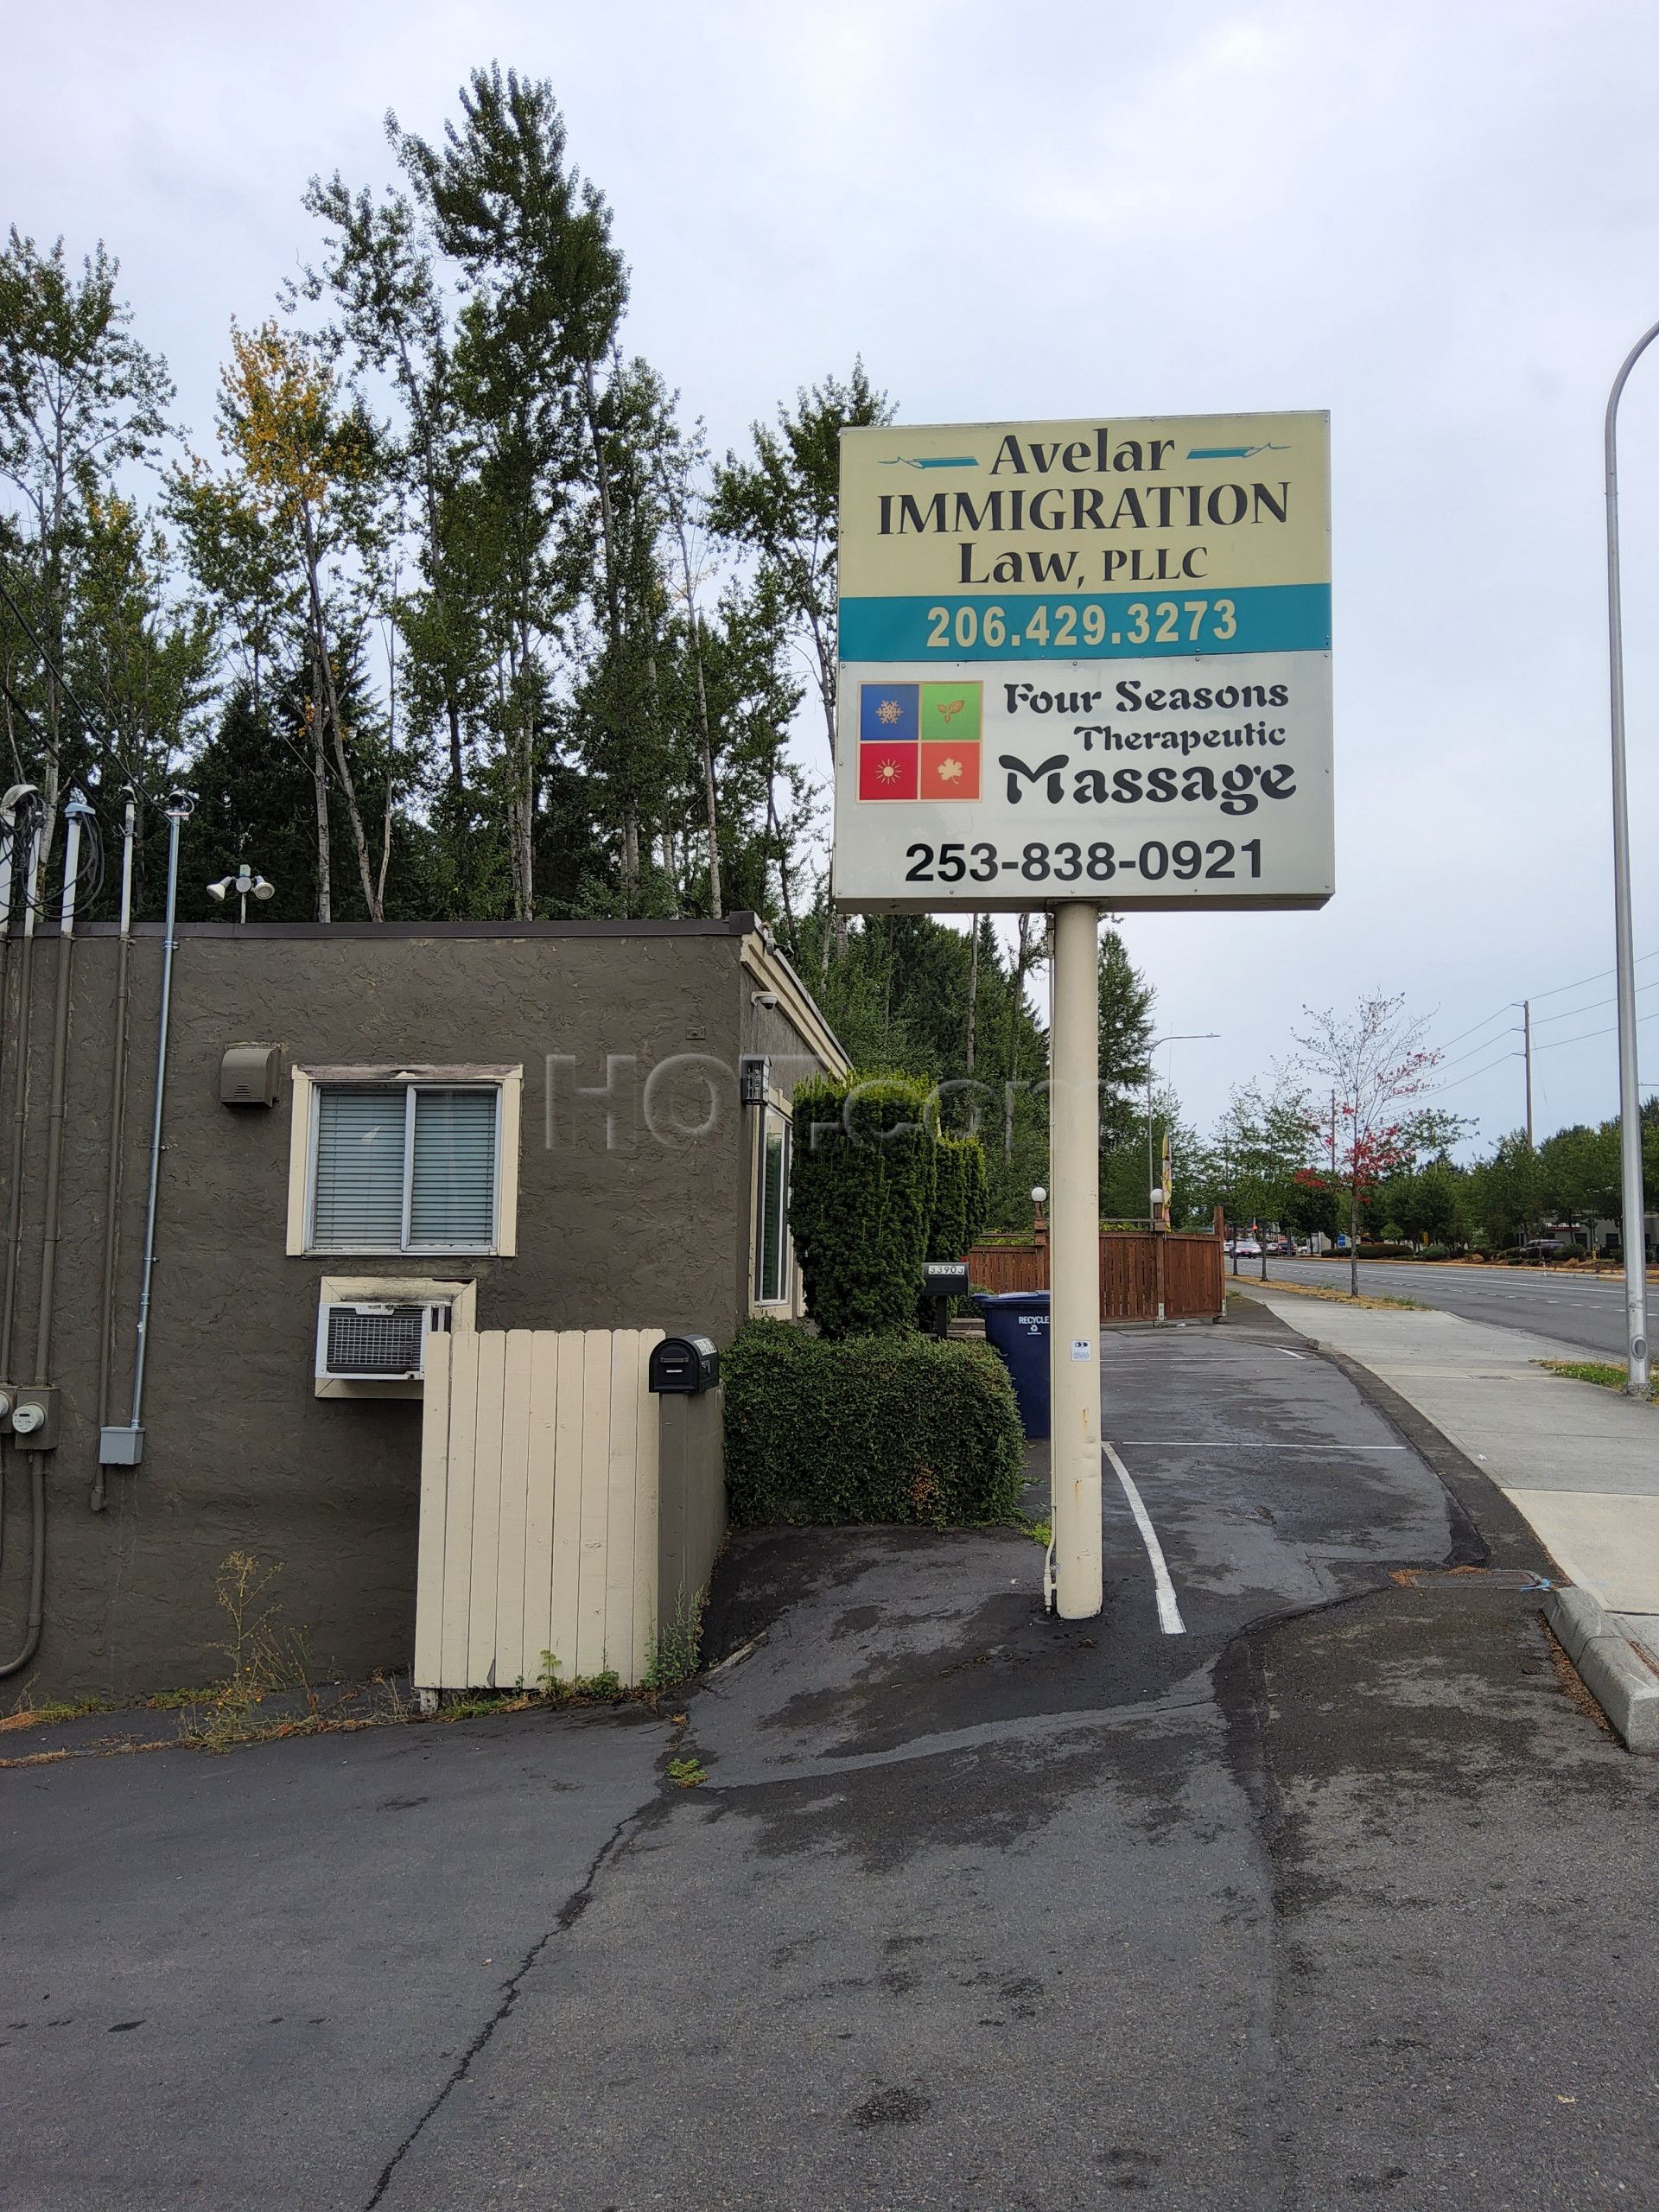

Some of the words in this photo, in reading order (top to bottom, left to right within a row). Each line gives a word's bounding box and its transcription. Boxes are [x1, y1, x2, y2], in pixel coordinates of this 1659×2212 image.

[989, 428, 1175, 475] Avelar
[877, 481, 1292, 535] IMMIGRATION
[957, 543, 1085, 589] Law,
[1102, 547, 1209, 582] PLLC
[926, 599, 1237, 647] 206.429.3273
[1003, 683, 1103, 715] Four
[1116, 680, 1289, 713] Seasons
[1074, 721, 1287, 756] Therapeutic
[998, 754, 1297, 816] Massage
[905, 838, 1262, 883] 253-838-0921
[929, 1265, 965, 1275] 33903
[1018, 1315, 1050, 1324] RECYCLE
